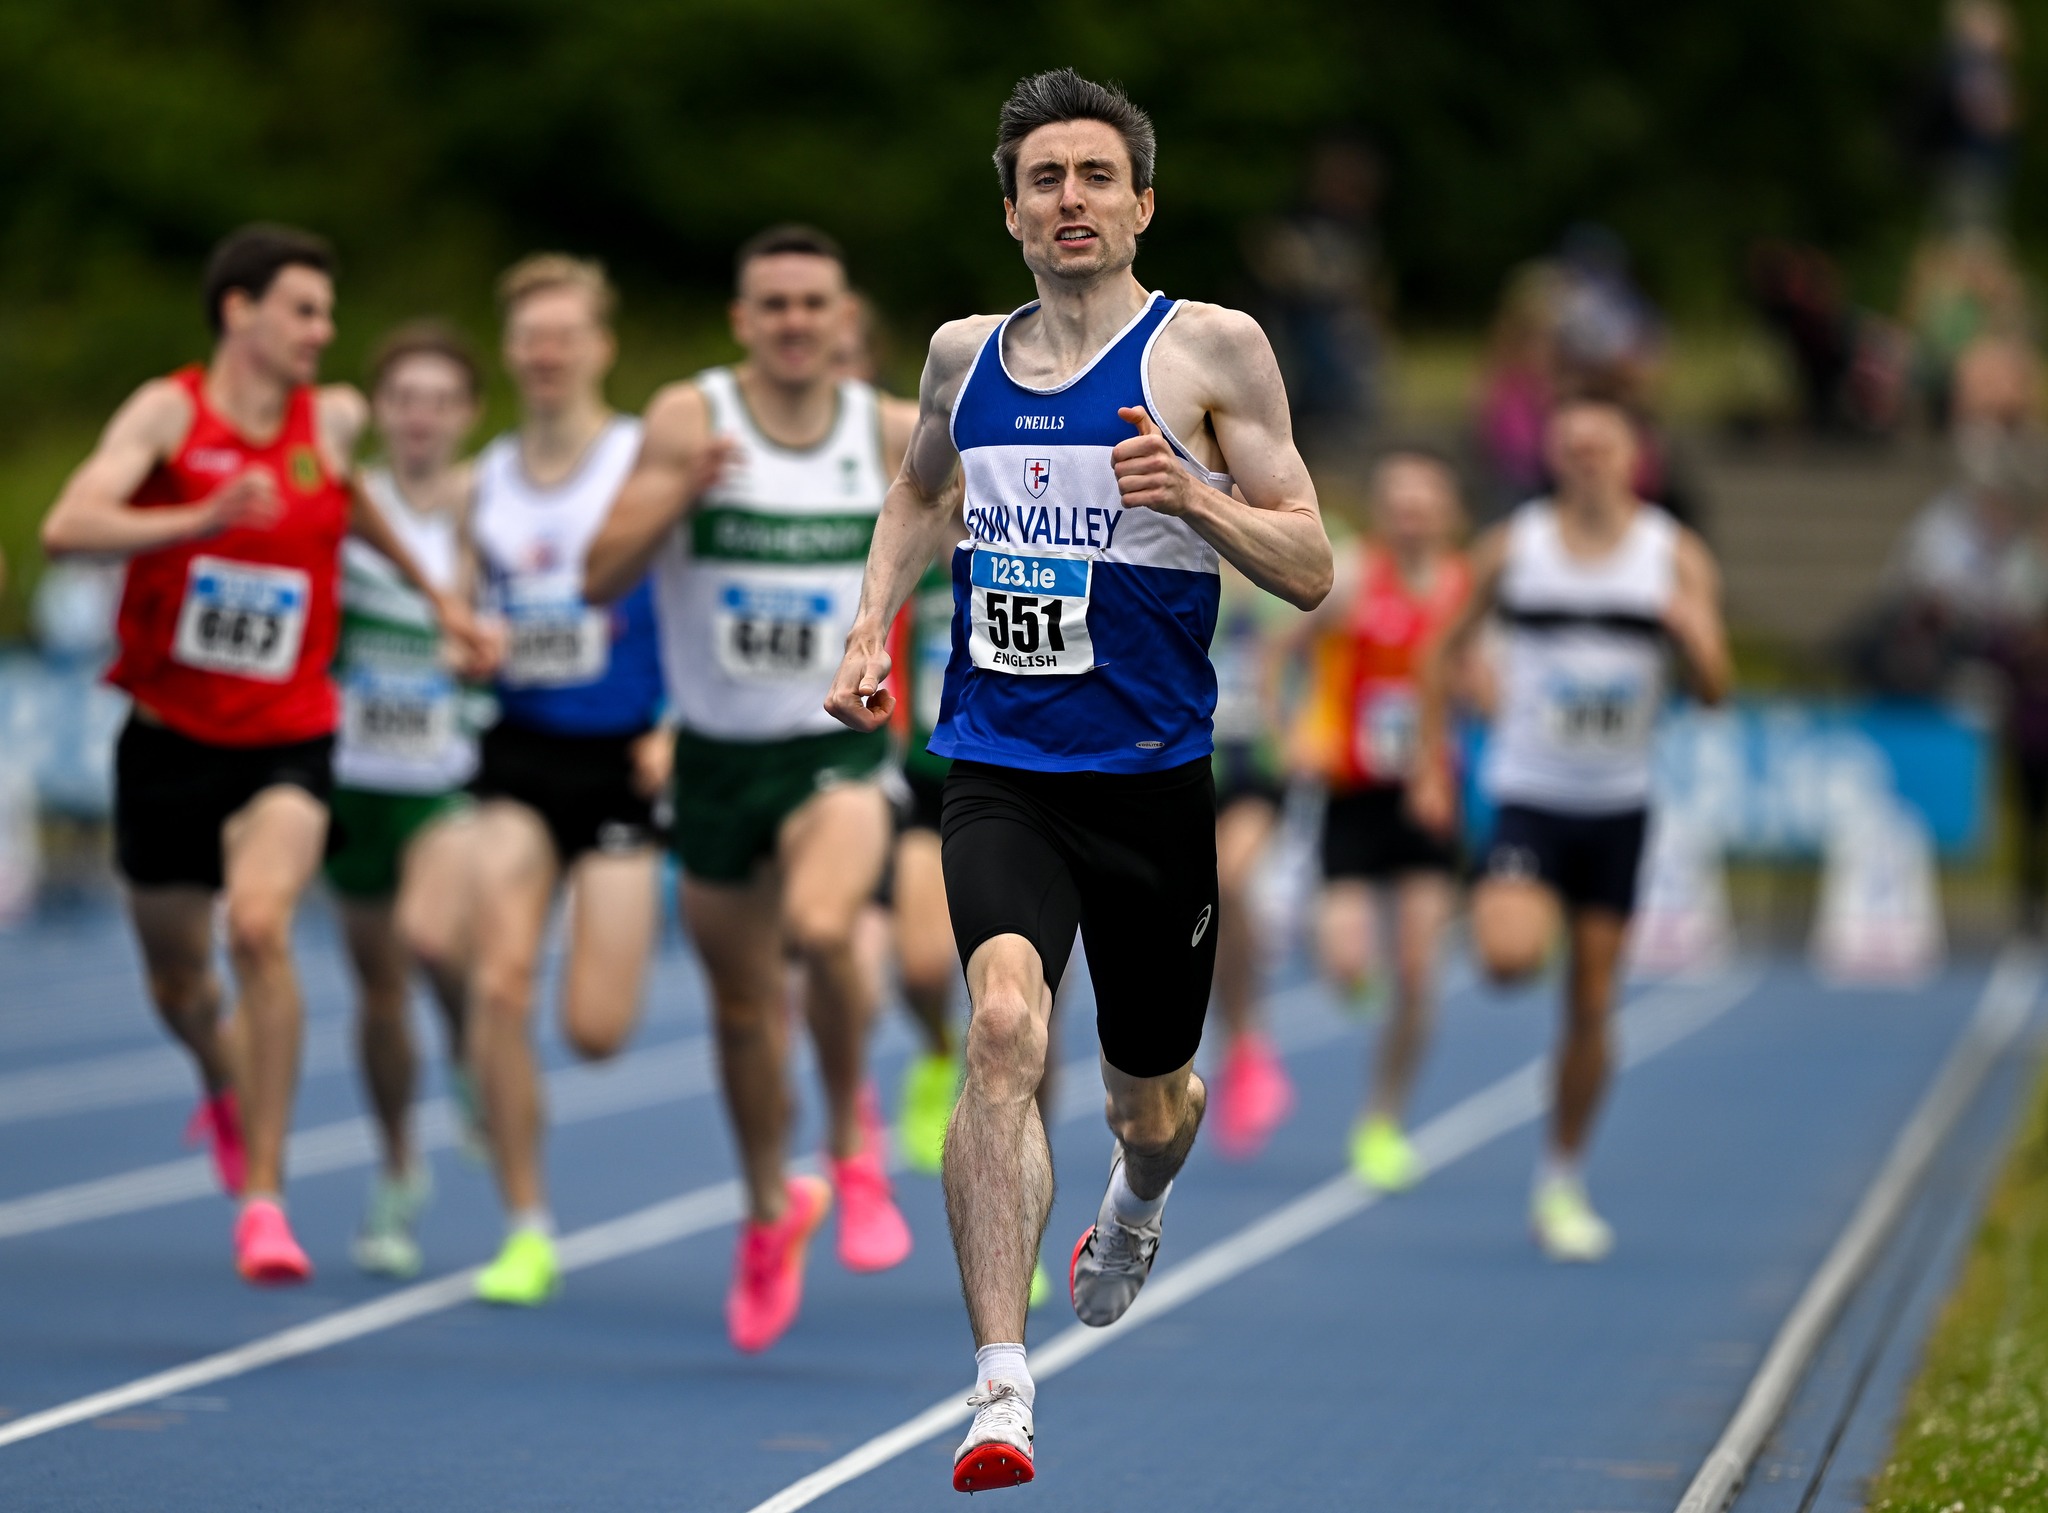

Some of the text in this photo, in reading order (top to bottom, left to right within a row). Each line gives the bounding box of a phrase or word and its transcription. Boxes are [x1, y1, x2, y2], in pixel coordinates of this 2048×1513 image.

[1015, 415, 1065, 430] O'NEILLS
[1016, 505, 1124, 549] VALLEY
[990, 556, 1056, 589] 123.ie
[986, 591, 1066, 654] 551
[992, 651, 1058, 668] ENGLISH
